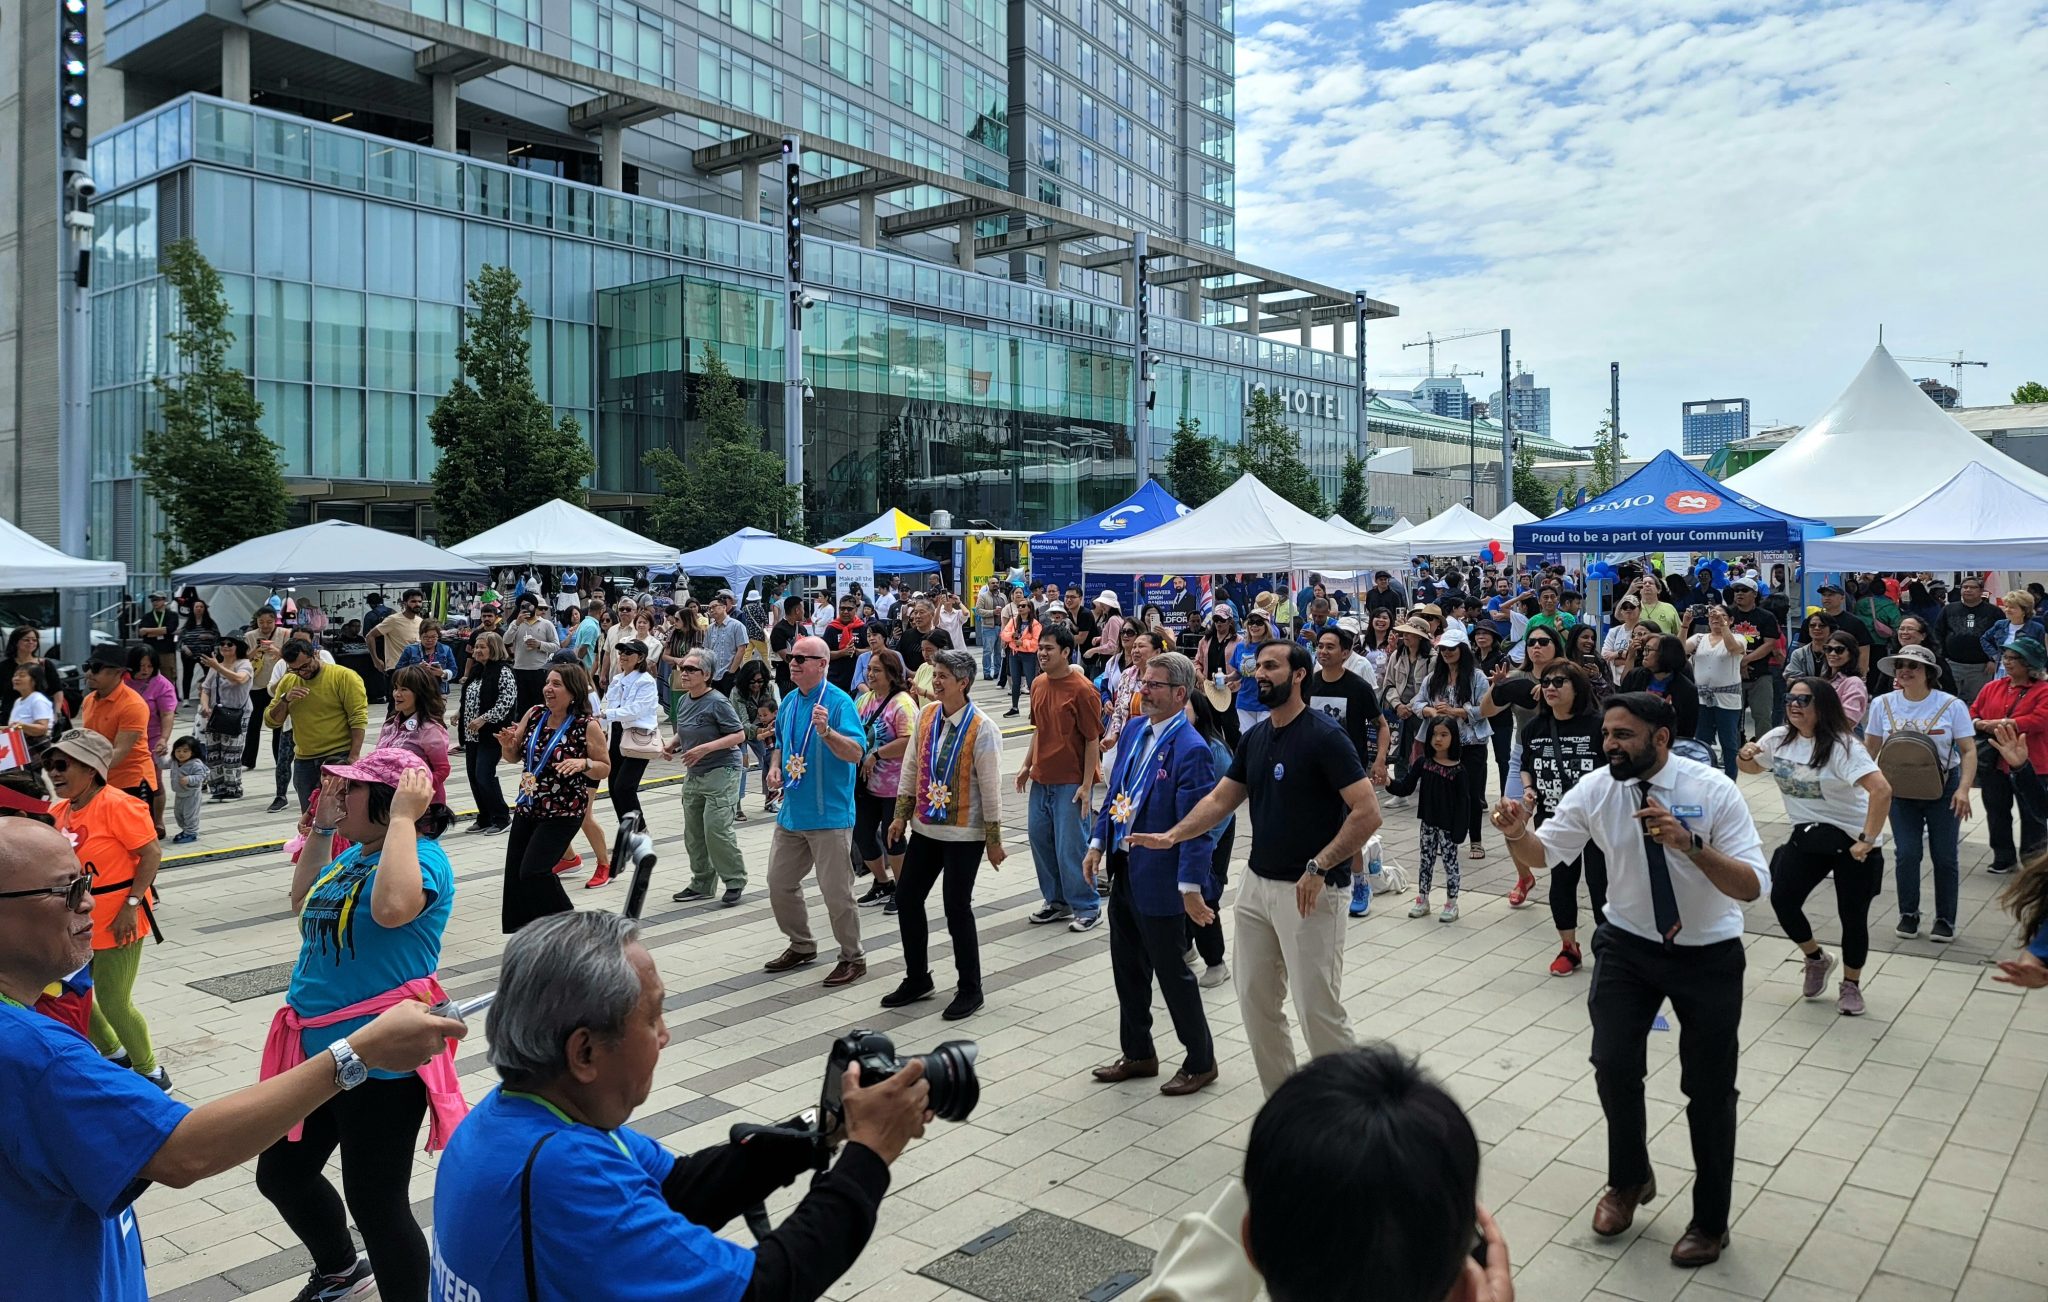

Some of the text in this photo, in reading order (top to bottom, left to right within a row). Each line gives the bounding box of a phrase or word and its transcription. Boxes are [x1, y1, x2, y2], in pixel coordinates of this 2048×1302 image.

[1279, 385, 1346, 420] HOTEL
[1588, 494, 1655, 514] BMO
[1532, 528, 1764, 544] Proud to be a part of your Community
